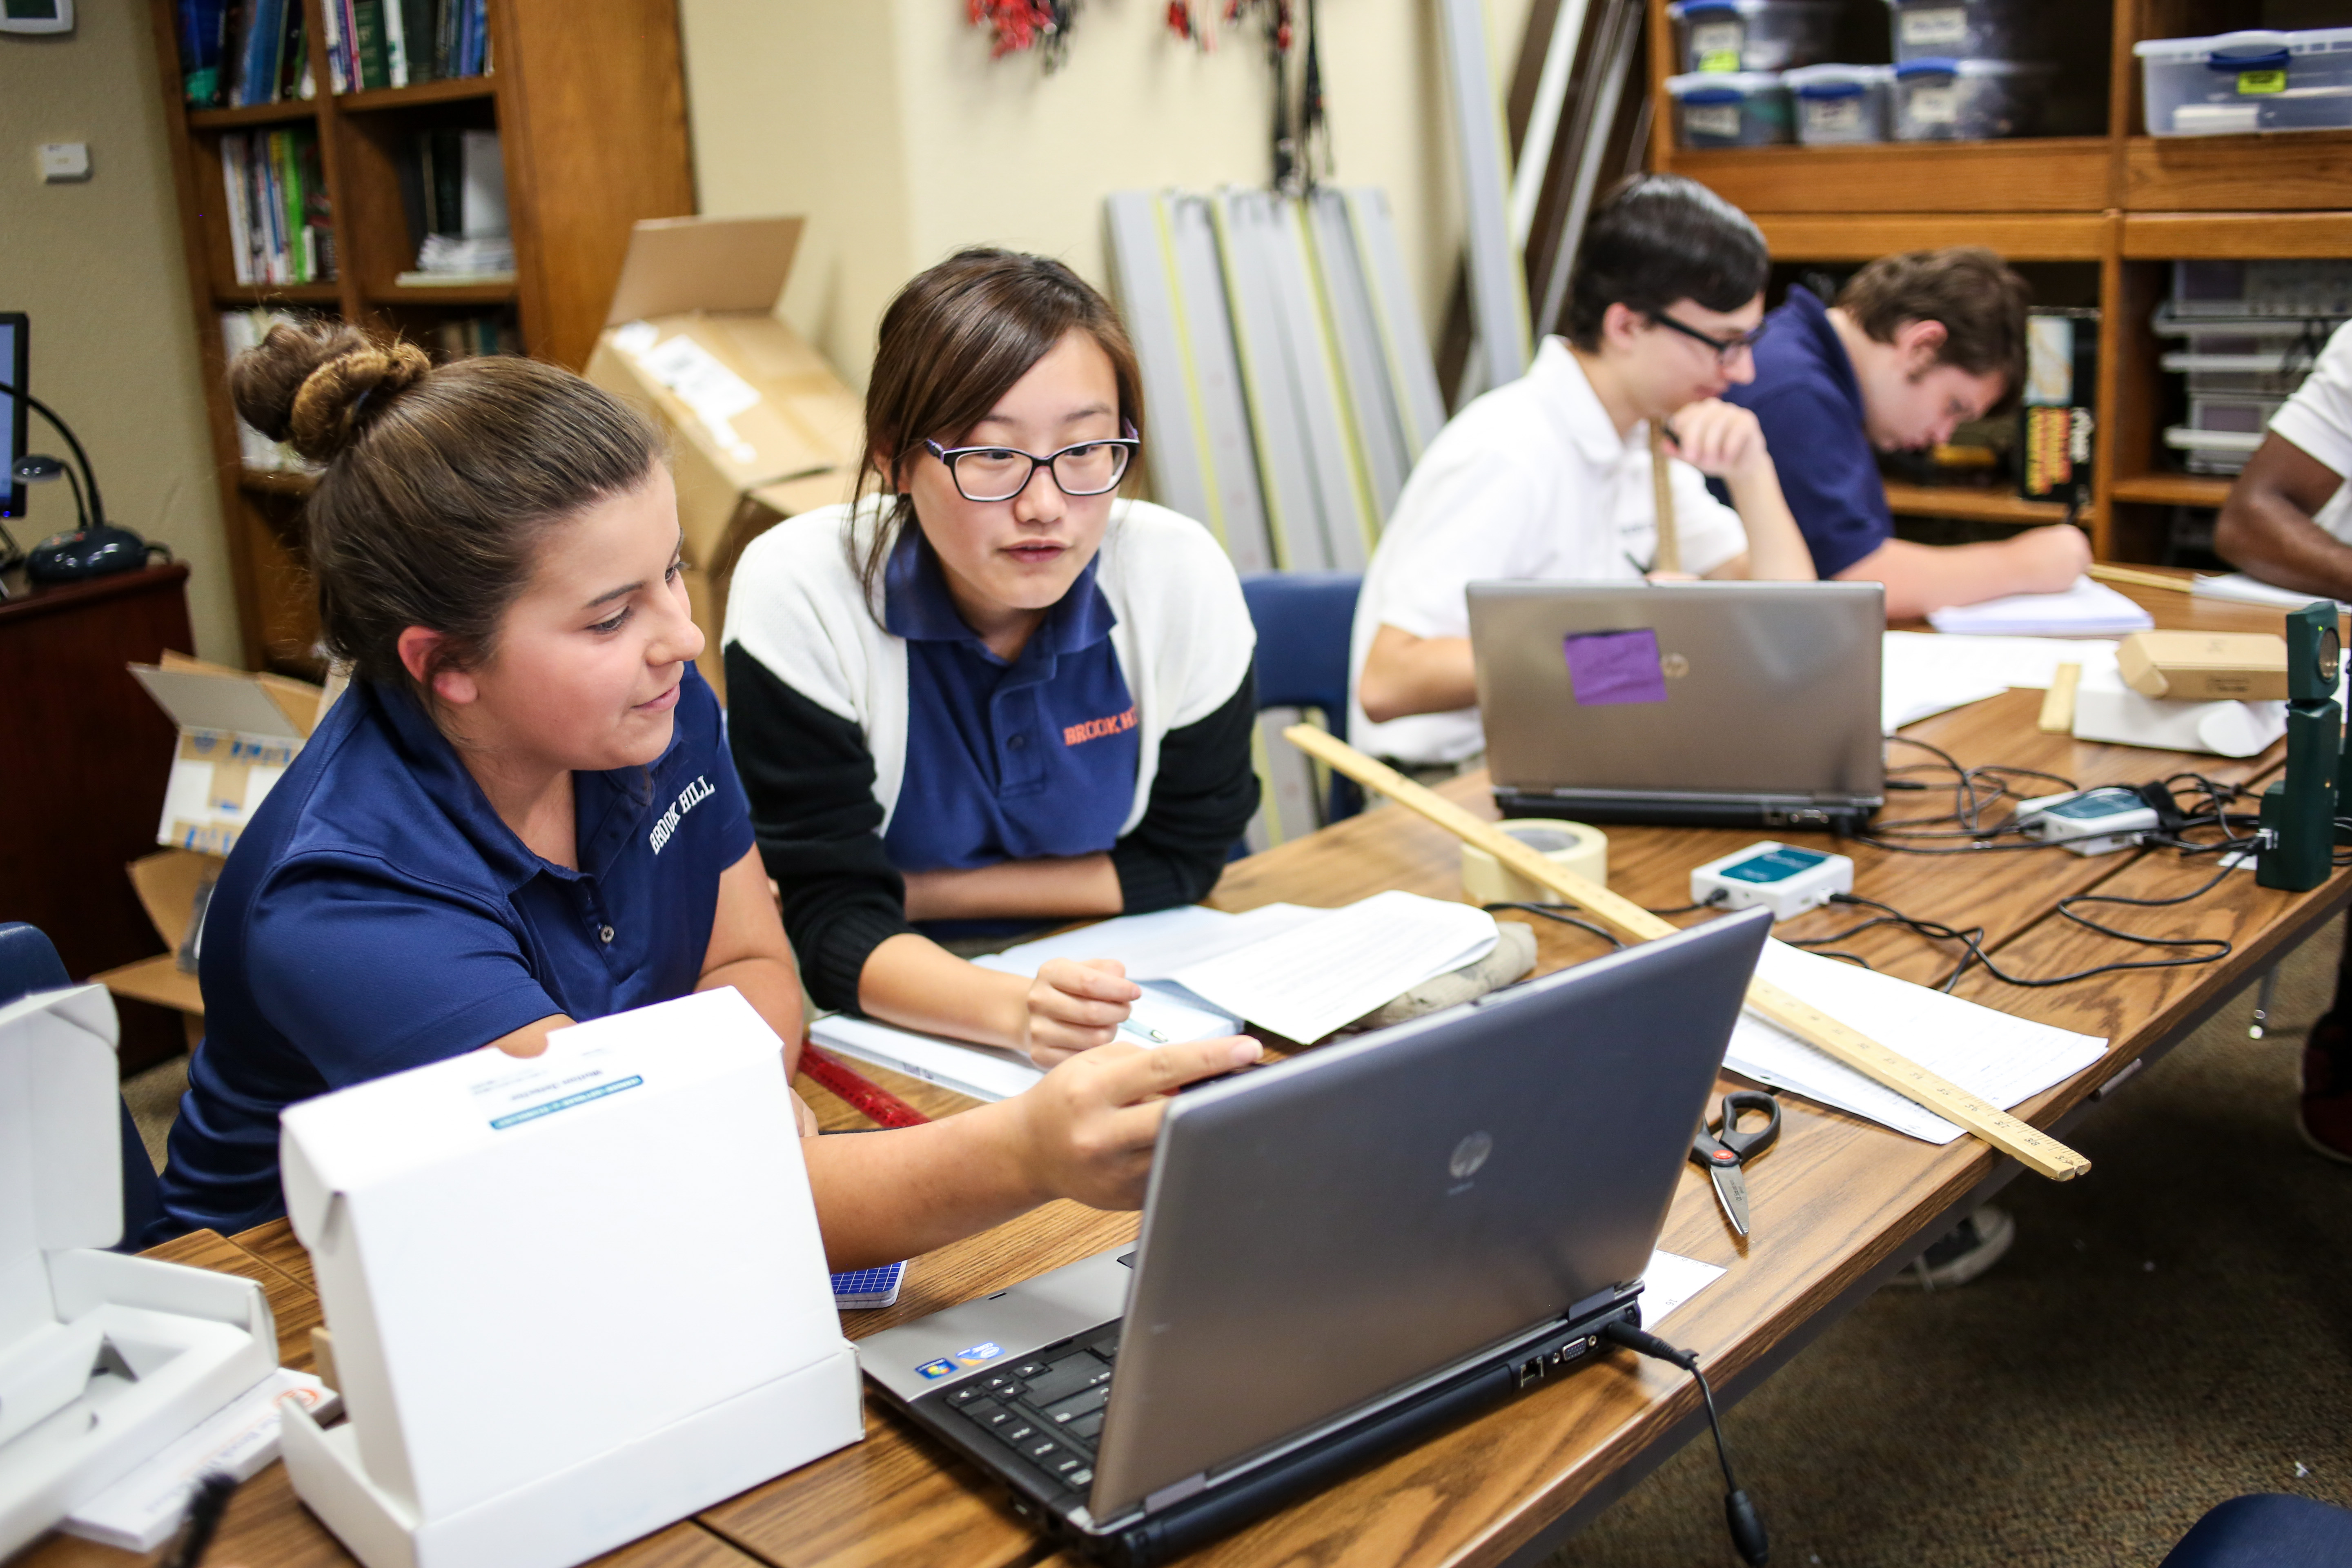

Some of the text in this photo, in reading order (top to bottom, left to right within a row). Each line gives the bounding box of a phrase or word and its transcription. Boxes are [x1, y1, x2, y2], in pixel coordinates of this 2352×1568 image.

[1063, 715, 1121, 746] BROOK
[649, 775, 715, 855] BROOK HILL
[2024, 1138, 2040, 1146] 38
